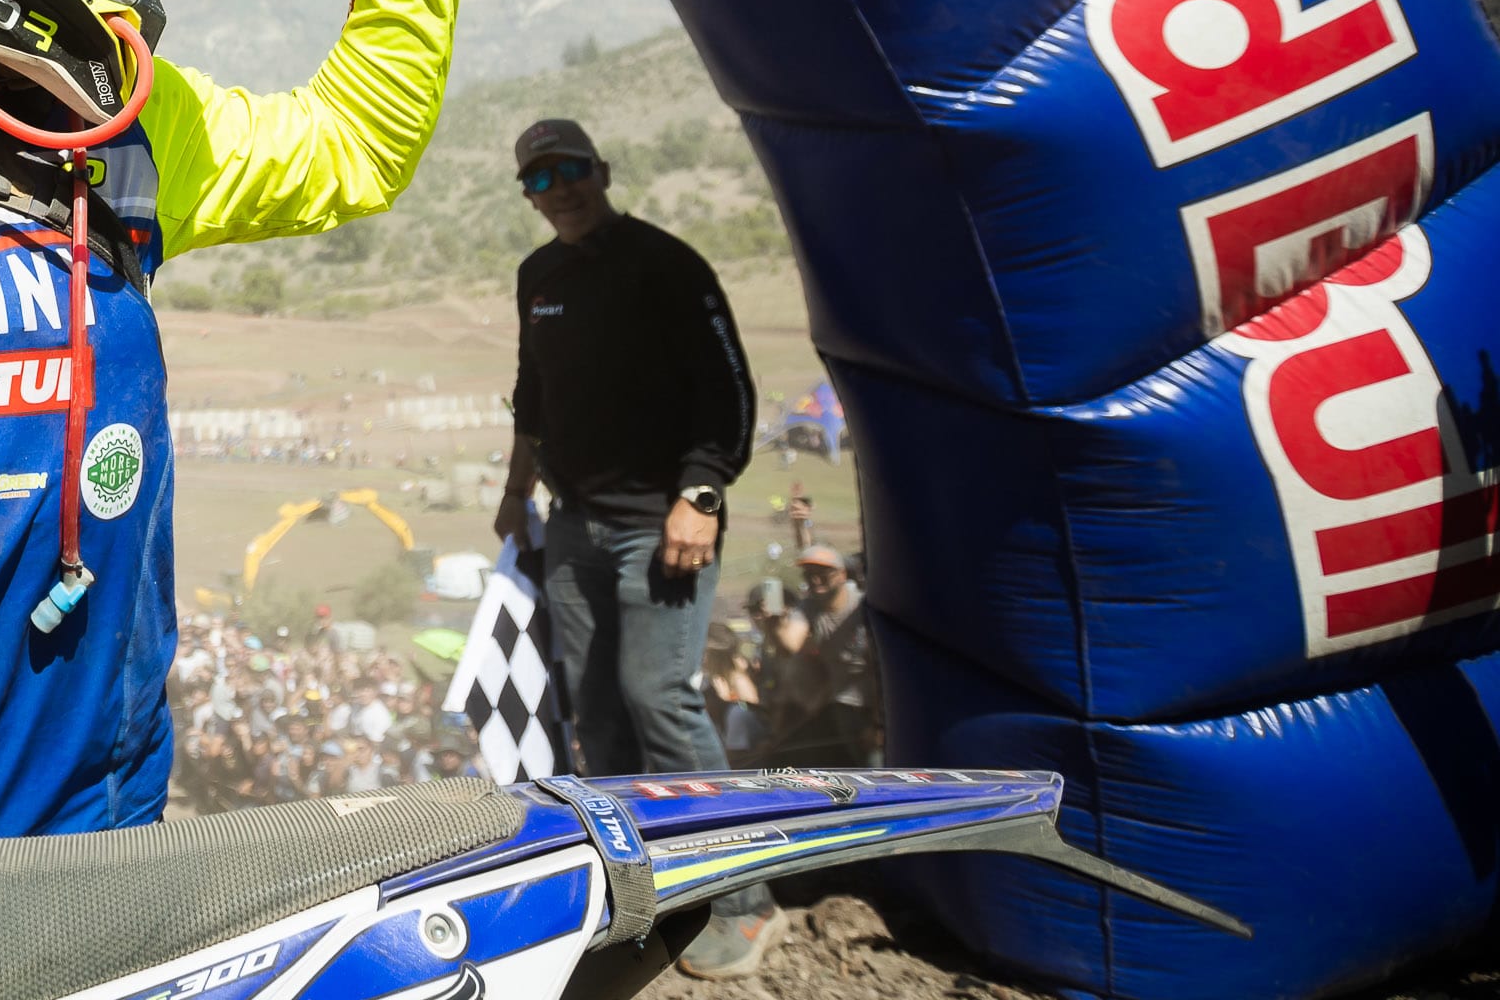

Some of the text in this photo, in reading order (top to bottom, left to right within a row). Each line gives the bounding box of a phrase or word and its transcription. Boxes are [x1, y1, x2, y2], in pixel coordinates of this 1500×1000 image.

[88, 59, 116, 107] AIROH
[1190, 125, 1500, 648] Bull
[100, 455, 131, 473] MORE
[100, 469, 131, 487] MOTO
[669, 830, 766, 850] MICHELIN
[168, 942, 281, 1000] 300
